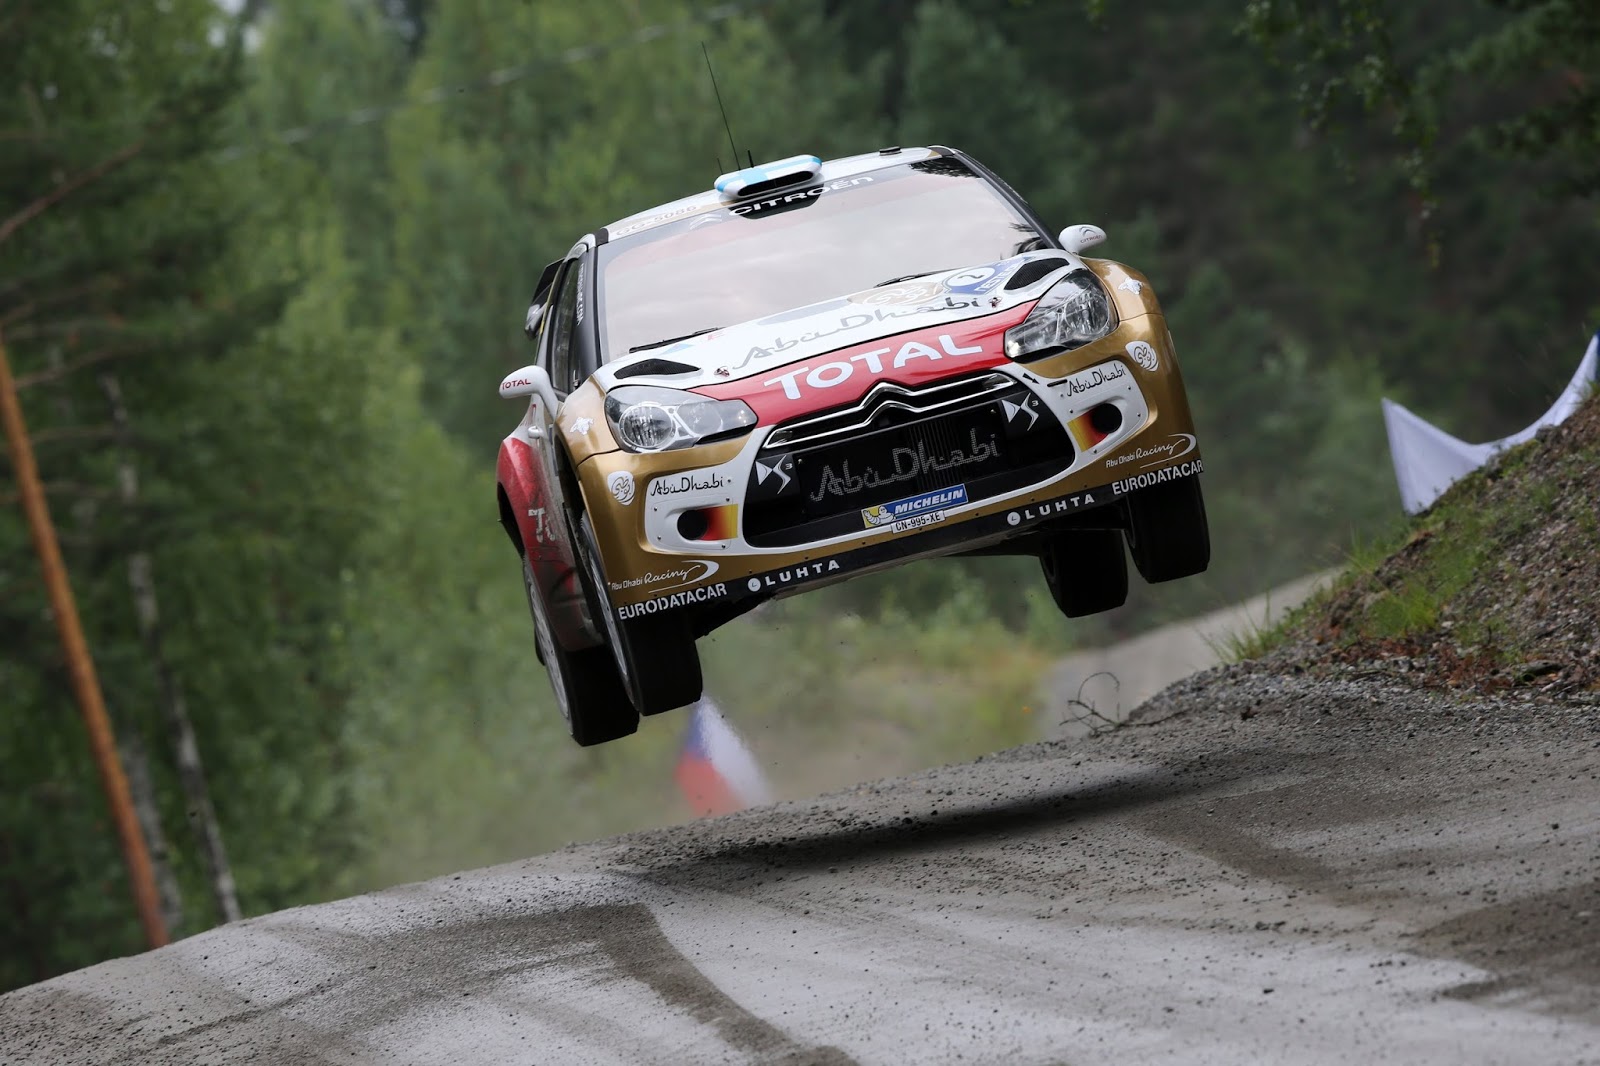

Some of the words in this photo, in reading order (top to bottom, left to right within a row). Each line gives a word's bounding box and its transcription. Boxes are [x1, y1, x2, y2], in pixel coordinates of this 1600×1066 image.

[728, 175, 873, 217] CITROËN
[764, 334, 982, 400] TOTAL
[502, 378, 531, 390] TOTAL
[1105, 459, 1119, 468] Abu
[1119, 452, 1136, 465] Dhabi
[1136, 438, 1186, 459] Racing
[1111, 459, 1204, 495] EURODATACAR
[895, 487, 964, 514] MICHELIN
[1025, 493, 1095, 520] LUHTA
[895, 512, 941, 533] CN-995-XE
[611, 580, 623, 591] Abu
[623, 576, 644, 589] Dhabi
[644, 565, 701, 584] Racing
[765, 559, 840, 586] LUHTA
[618, 583, 727, 620] EURODATACAR
